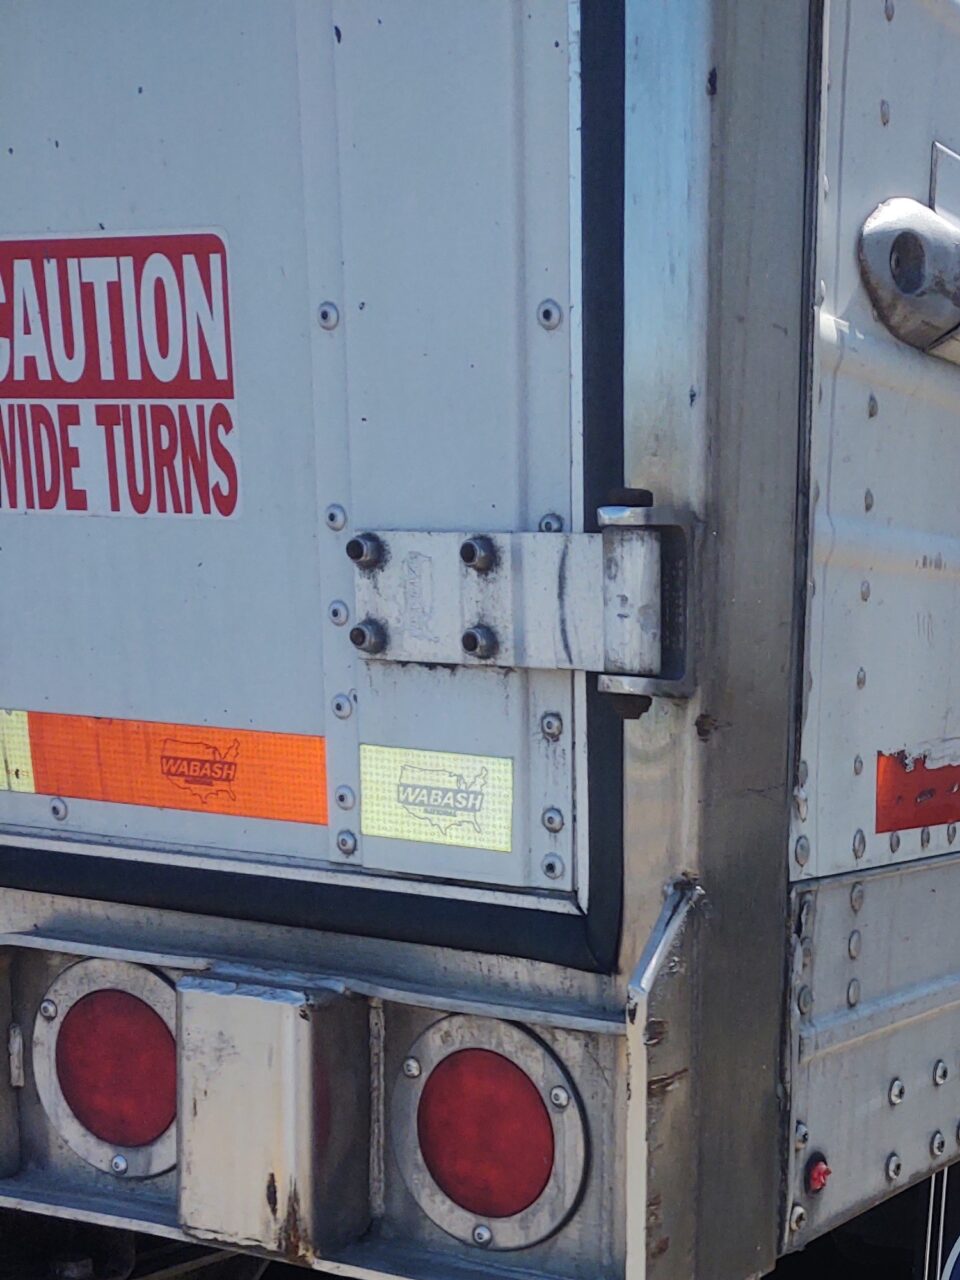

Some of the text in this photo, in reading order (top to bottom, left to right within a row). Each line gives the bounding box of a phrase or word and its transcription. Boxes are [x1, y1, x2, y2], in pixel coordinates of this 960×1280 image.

[0, 252, 229, 383] AUTION
[95, 402, 238, 517] TURNS
[161, 757, 236, 781] WABASH
[399, 785, 482, 811] WABASH
